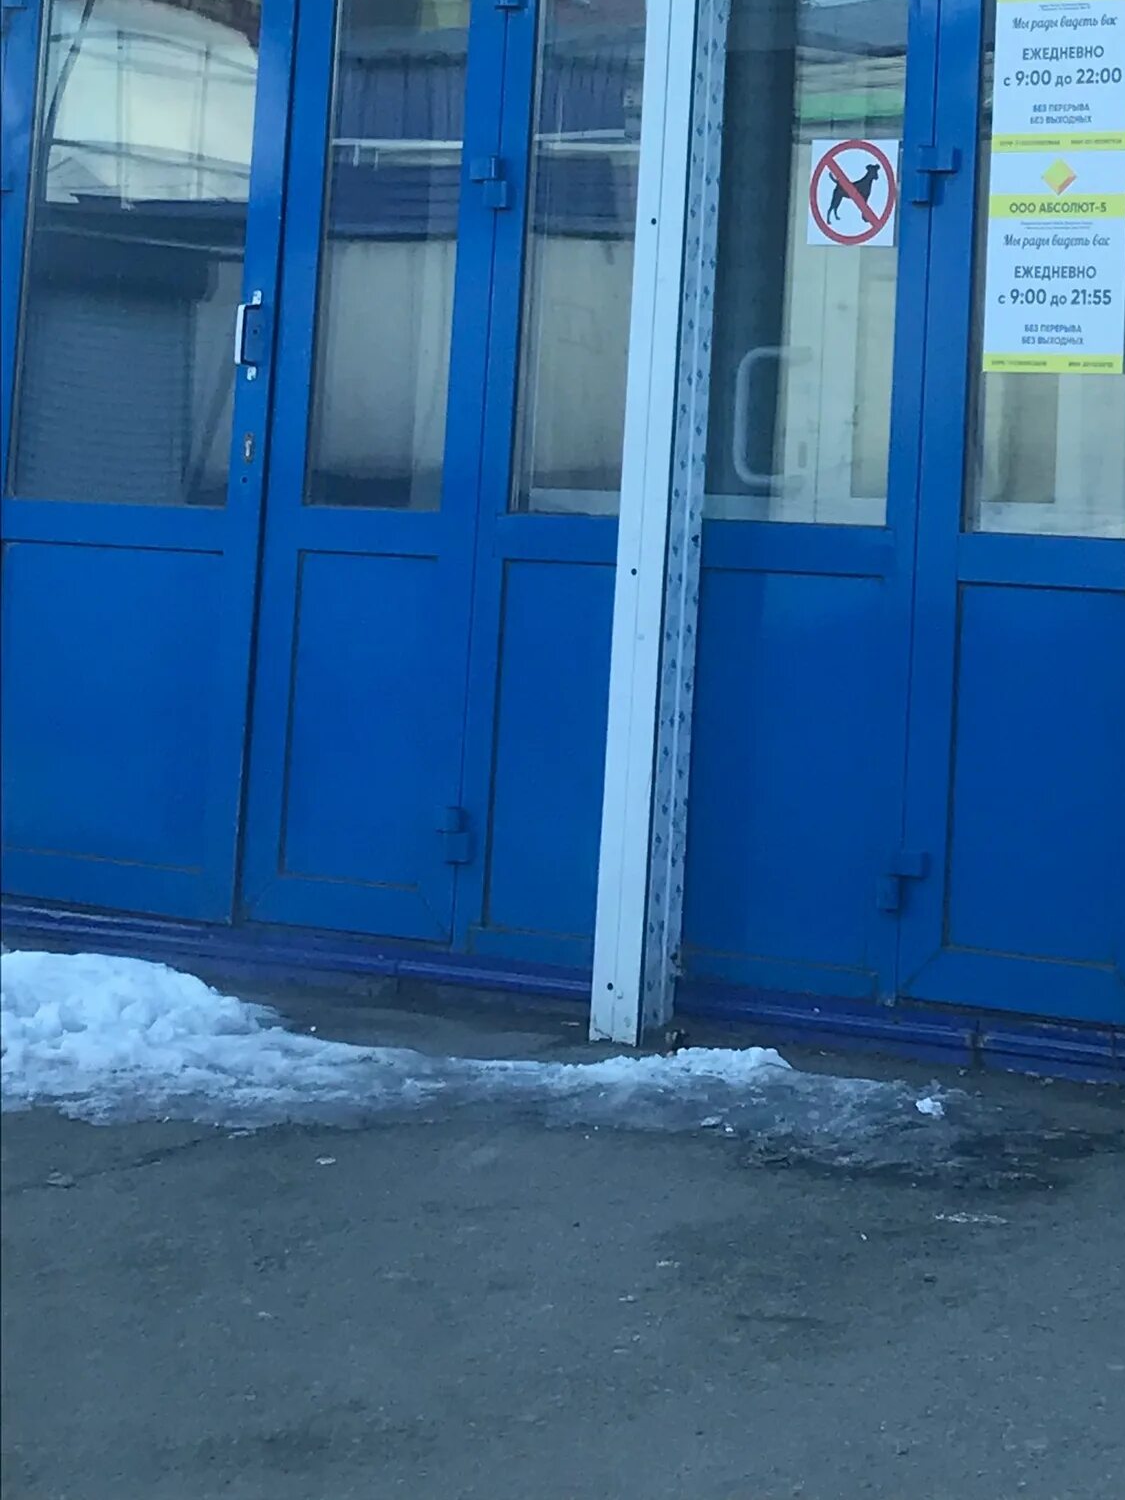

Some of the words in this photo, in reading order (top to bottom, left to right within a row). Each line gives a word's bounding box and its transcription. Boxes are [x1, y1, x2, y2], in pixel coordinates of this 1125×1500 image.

[1012, 16, 1030, 30] Мы
[1030, 17, 1059, 32] рады
[1060, 15, 1098, 31] видеть
[1100, 13, 1118, 26] вас
[1022, 45, 1105, 62] ЕЖЕДНЕВНО
[1003, 76, 1011, 87] с
[1015, 69, 1052, 87] 9:00
[1054, 74, 1072, 88] до
[1075, 67, 1122, 85] 22:00
[1009, 202, 1036, 214] ООО
[1038, 201, 1107, 213] АБСОЛЮТ-5
[1003, 234, 1021, 246] Мы
[1022, 235, 1050, 250] рады
[1051, 233, 1090, 250] видеть
[1092, 233, 1111, 247] вас
[1014, 265, 1097, 281] ЕЖЕДНЕВНО
[997, 293, 1006, 305] с
[1009, 288, 1047, 305] 9:00
[1050, 294, 1067, 307] до
[1070, 289, 1112, 305] 21:55
[1024, 323, 1039, 333] БЕЗ
[1040, 323, 1082, 333] ПЕРЕРЫВА
[1021, 336, 1036, 345] БЕЗ
[1037, 336, 1084, 346] ВЫХОДНЫХ
